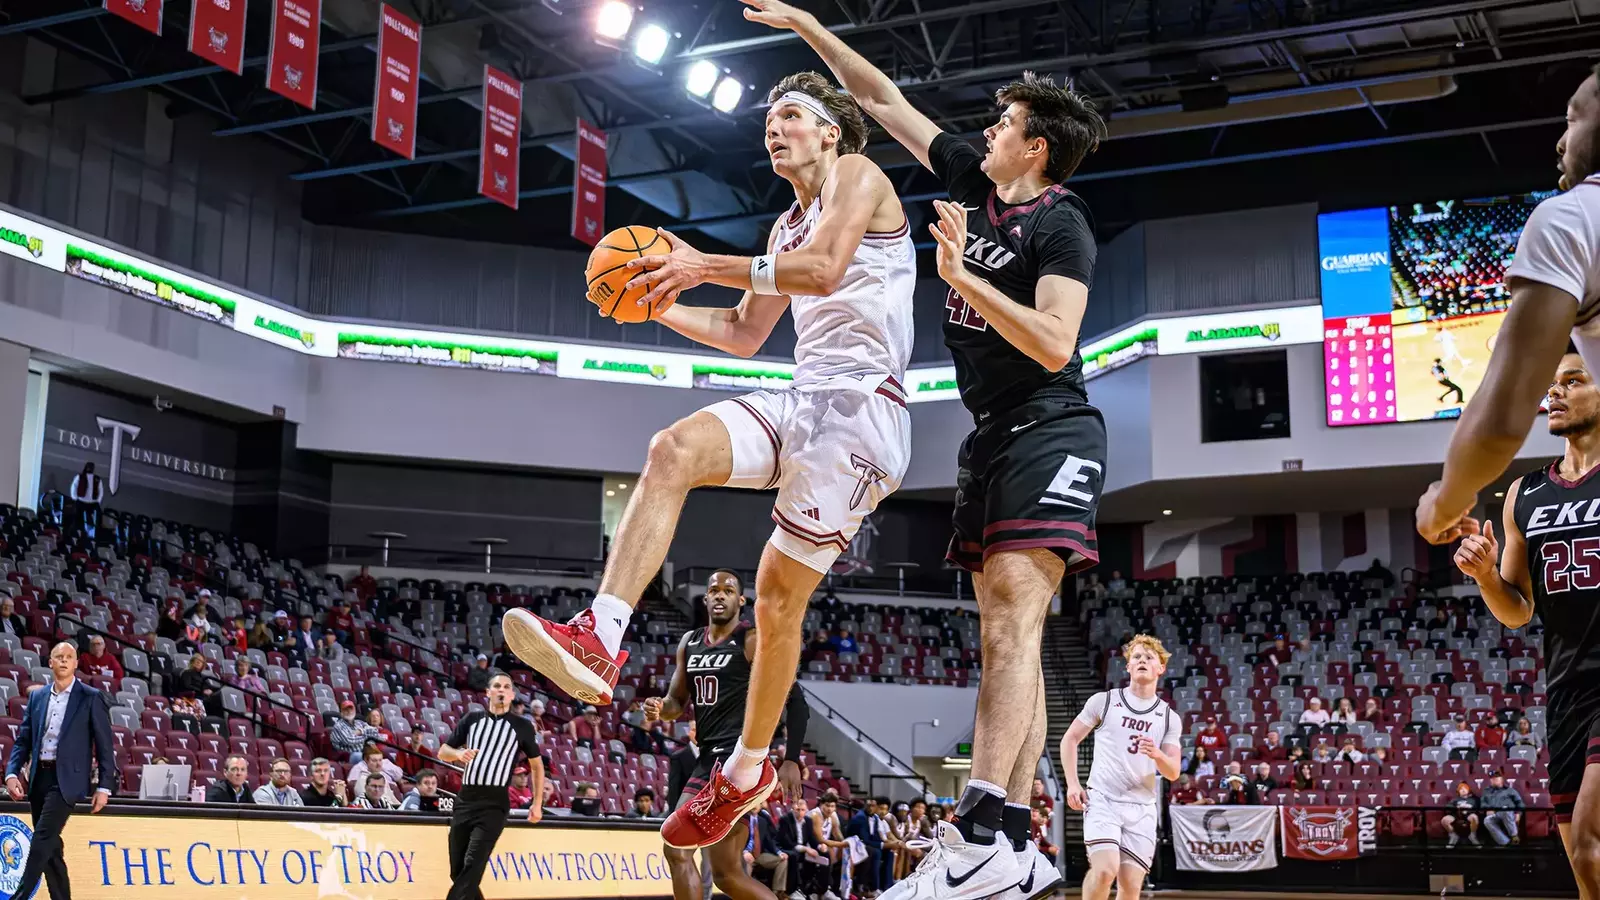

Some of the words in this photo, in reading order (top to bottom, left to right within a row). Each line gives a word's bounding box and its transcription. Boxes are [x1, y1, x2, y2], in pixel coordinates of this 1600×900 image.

[384, 13, 418, 42] VOLLEYBALL
[488, 75, 520, 99] VOLLEYBALL
[1322, 251, 1388, 271] GUARDIAN
[254, 315, 301, 339] ALABAMA
[1186, 325, 1262, 342] ALABAMA
[583, 359, 651, 375] ALABAMA
[58, 429, 102, 451] TROY
[131, 447, 227, 481] UNIVERSITY
[1042, 454, 1102, 504] E
[1540, 536, 1600, 595] 25
[686, 654, 733, 668] EKU
[694, 675, 719, 706] 10
[1121, 715, 1153, 733] TROY
[1307, 823, 1337, 841] TROY
[1358, 805, 1377, 853] TROY
[1187, 838, 1265, 856] TROJANS
[88, 840, 175, 886] THE
[187, 841, 270, 886] CITY
[281, 849, 323, 885] OF
[332, 844, 416, 885] TROY
